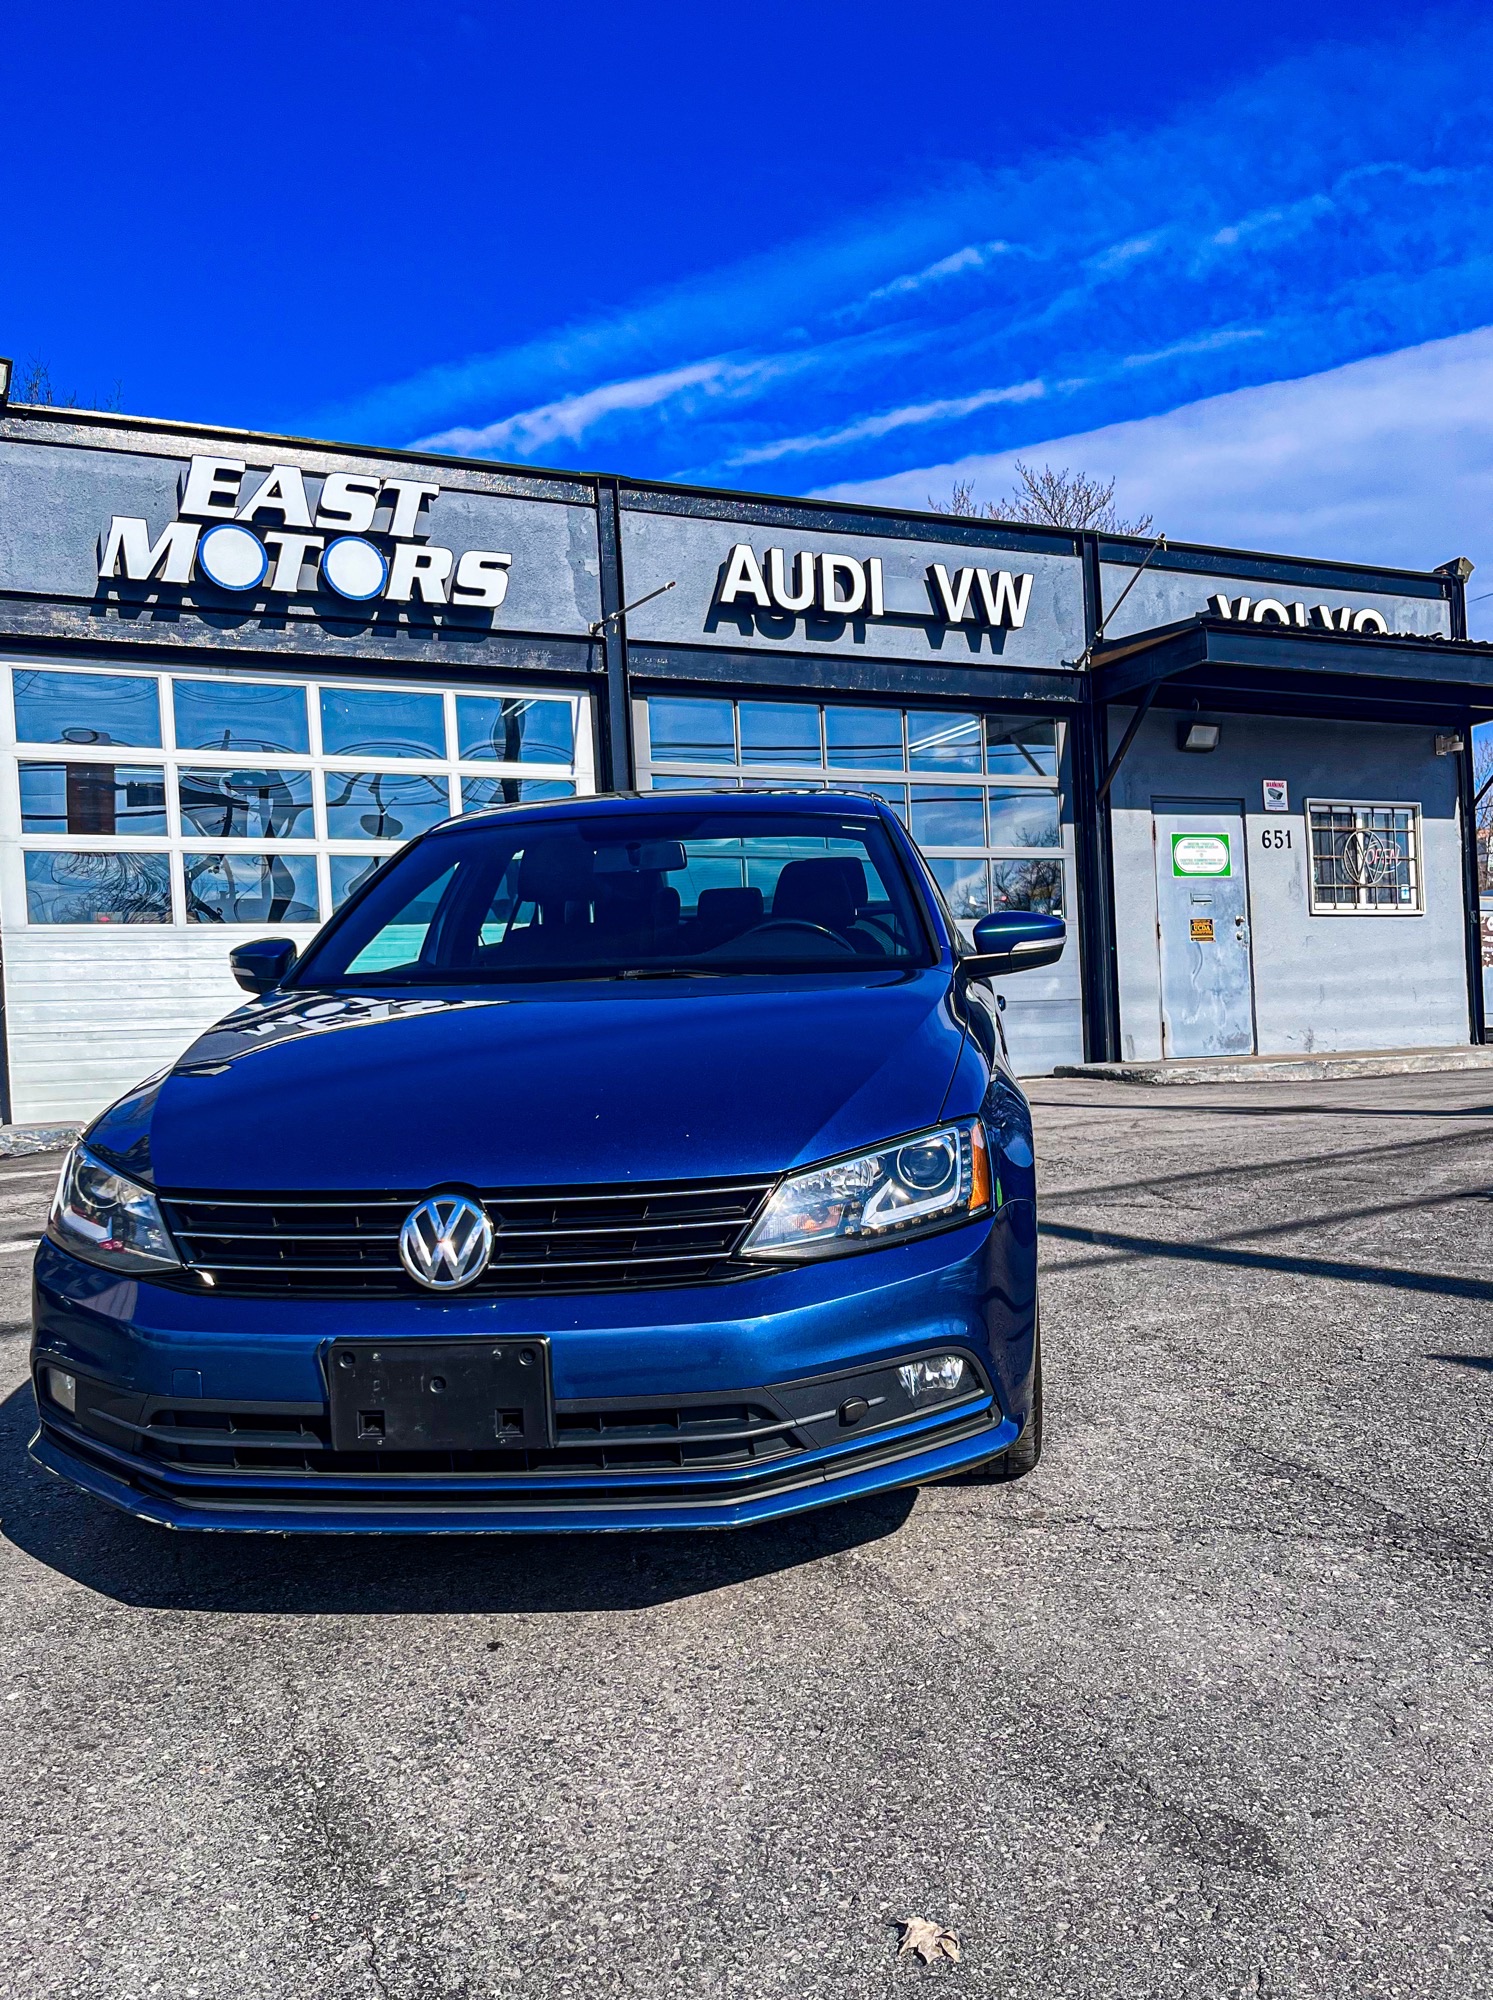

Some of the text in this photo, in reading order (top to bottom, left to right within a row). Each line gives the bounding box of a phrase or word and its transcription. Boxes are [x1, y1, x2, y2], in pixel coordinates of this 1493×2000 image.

[179, 456, 440, 538] EAST
[99, 516, 512, 607] MOTORS
[720, 544, 1034, 628] AUDI VW
[1261, 829, 1292, 849] 651
[1365, 848, 1401, 865] OPEN
